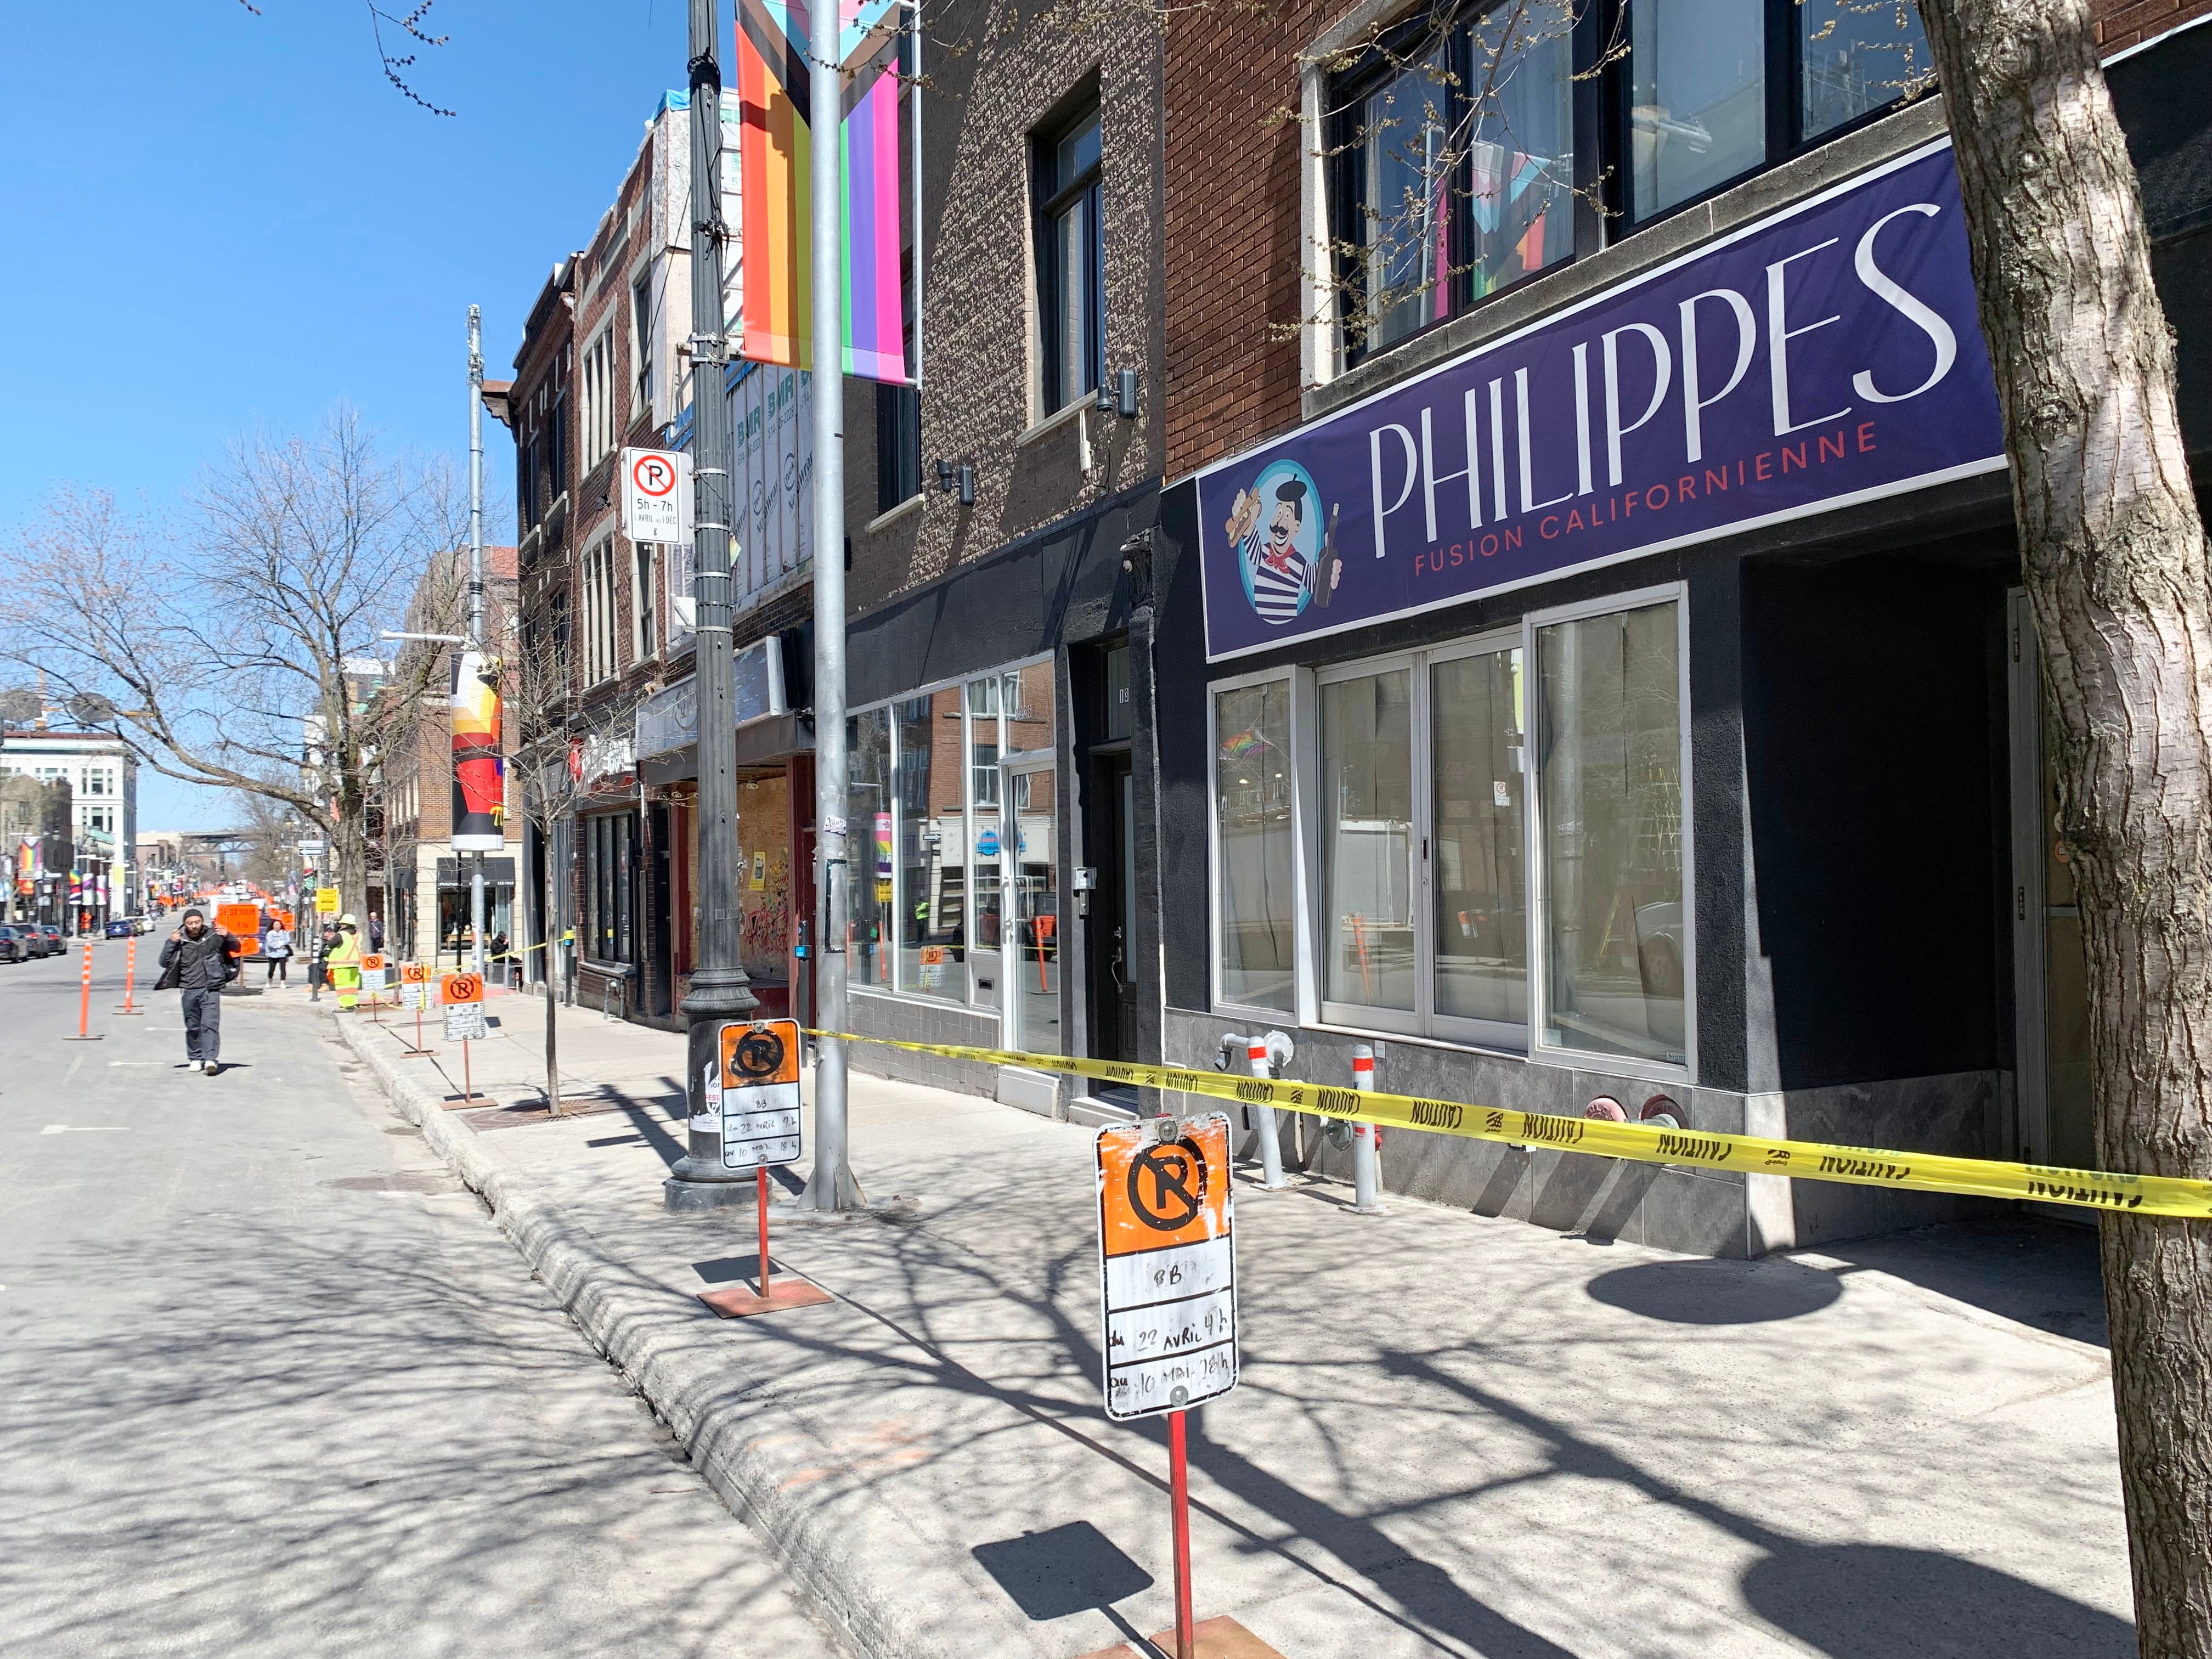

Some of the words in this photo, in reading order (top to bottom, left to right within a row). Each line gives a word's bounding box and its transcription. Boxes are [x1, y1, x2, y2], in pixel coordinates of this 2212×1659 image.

[1370, 203, 1957, 558] PHILIPPES
[637, 499, 650, 510] 5h
[661, 500, 673, 512] 7h
[1414, 525, 1523, 577] FUSION
[1540, 421, 1877, 540] CALIFORNIENNE
[638, 514, 653, 522] AVRIL
[1015, 704, 1032, 721] 1326
[1166, 1071, 1198, 1092] CAUTION
[1235, 1079, 1274, 1104] CAUTION
[1314, 1088, 1361, 1115] CAUTION
[1409, 1099, 1463, 1129] CAUTION
[1521, 1113, 1584, 1144] CAUTION
